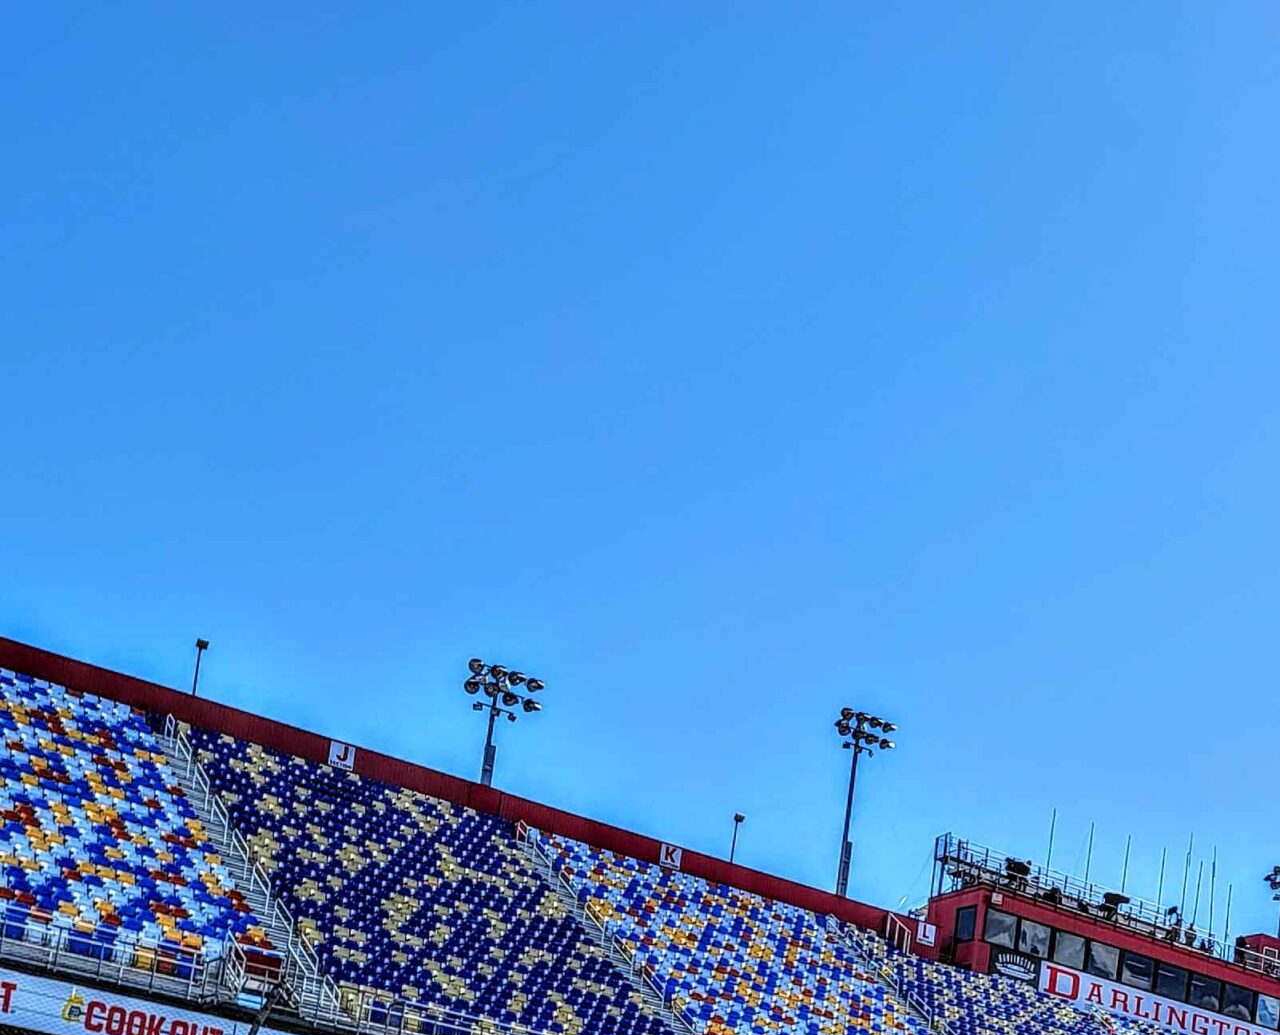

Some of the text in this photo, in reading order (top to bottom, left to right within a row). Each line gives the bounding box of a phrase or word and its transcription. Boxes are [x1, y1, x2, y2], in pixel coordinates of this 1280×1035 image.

[336, 746, 349, 761] J
[664, 846, 677, 863] K
[922, 923, 931, 939] L
